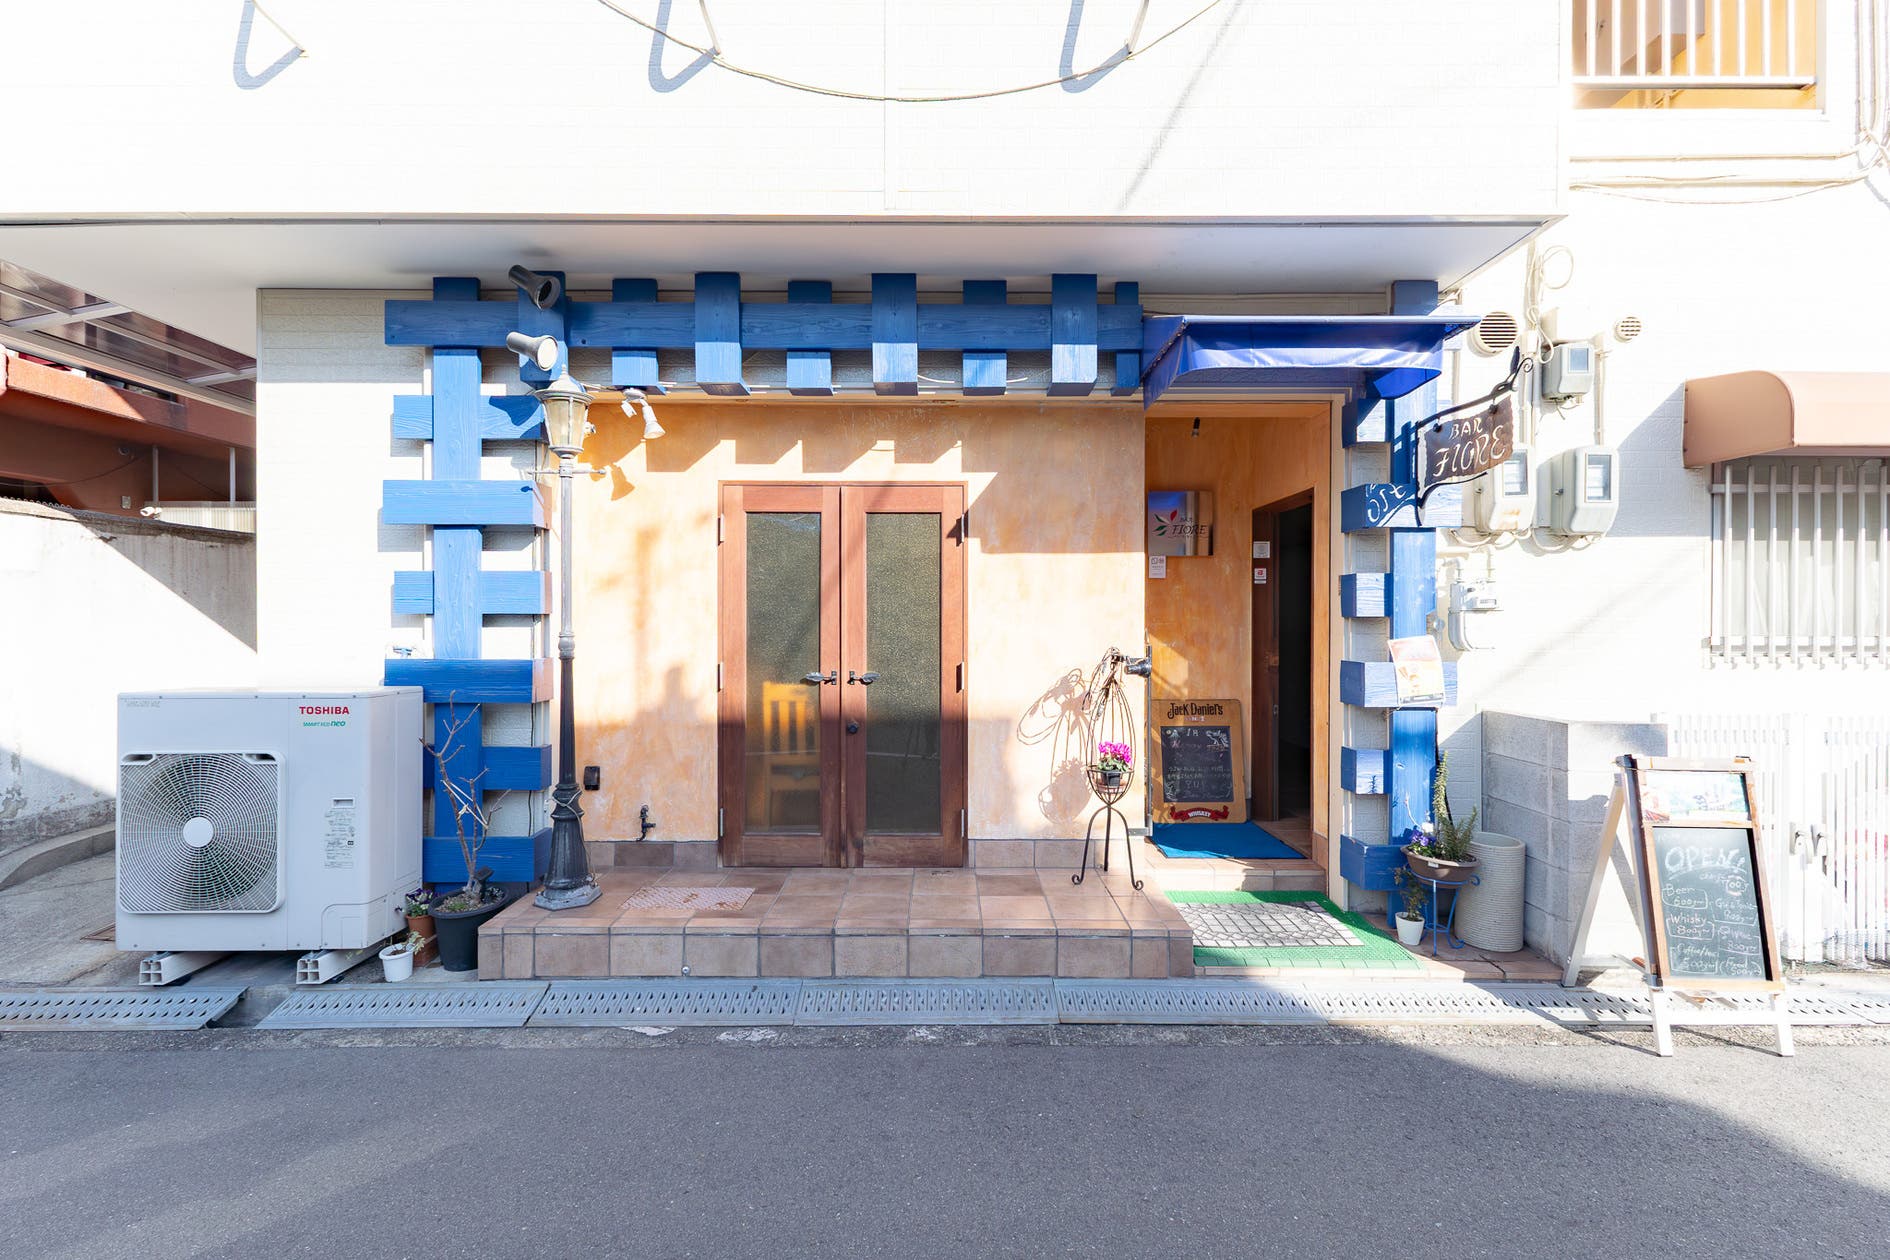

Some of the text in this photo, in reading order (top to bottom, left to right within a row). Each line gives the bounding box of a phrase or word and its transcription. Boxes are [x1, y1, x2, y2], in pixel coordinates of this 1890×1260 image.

[1449, 417, 1483, 439] BAR
[1433, 425, 1505, 477] FIORE
[299, 706, 350, 715] TOSHIBA
[1190, 703, 1223, 717] Daniel's
[1664, 883, 1695, 896] Beer
[1670, 912, 1707, 928] Whisky
